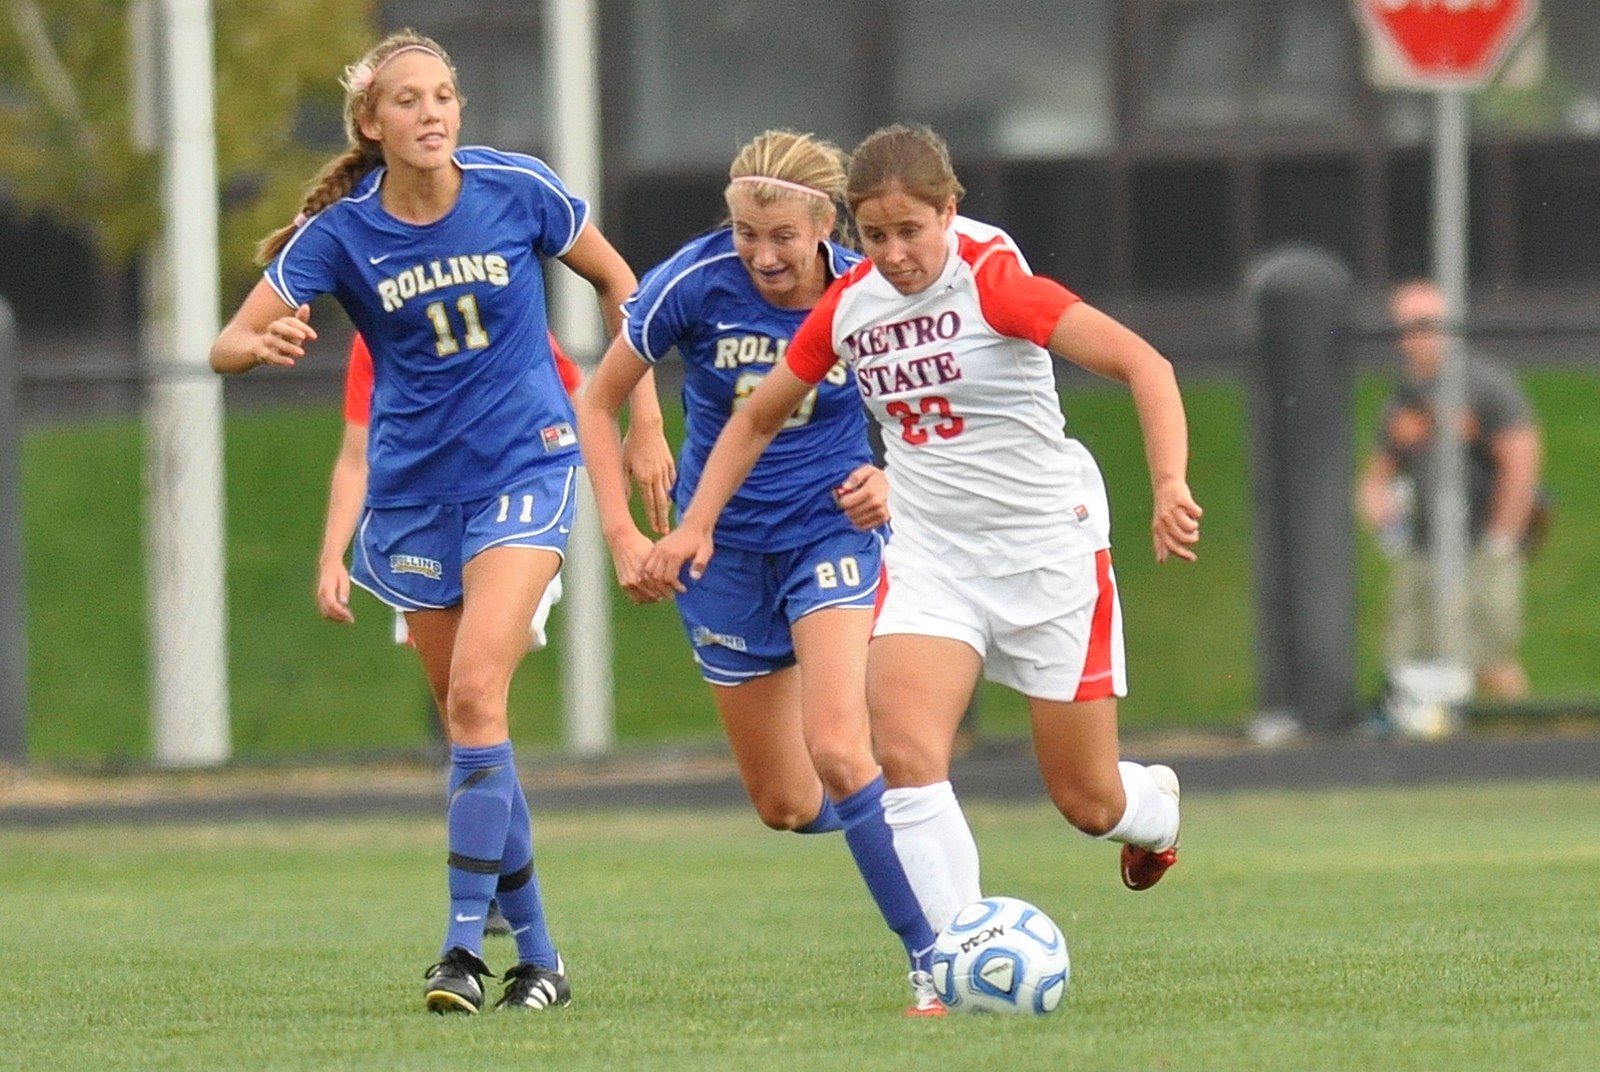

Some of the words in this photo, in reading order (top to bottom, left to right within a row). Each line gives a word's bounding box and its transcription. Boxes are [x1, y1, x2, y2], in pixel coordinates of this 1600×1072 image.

[377, 254, 510, 313] ROLLINS
[426, 293, 490, 357] 11
[841, 310, 962, 362] METRO
[714, 334, 848, 386] ROLLS
[857, 351, 962, 397] STATE
[886, 395, 964, 446] 23
[496, 494, 534, 523] 11
[391, 555, 442, 574] ROLLINS
[815, 557, 861, 588] 20
